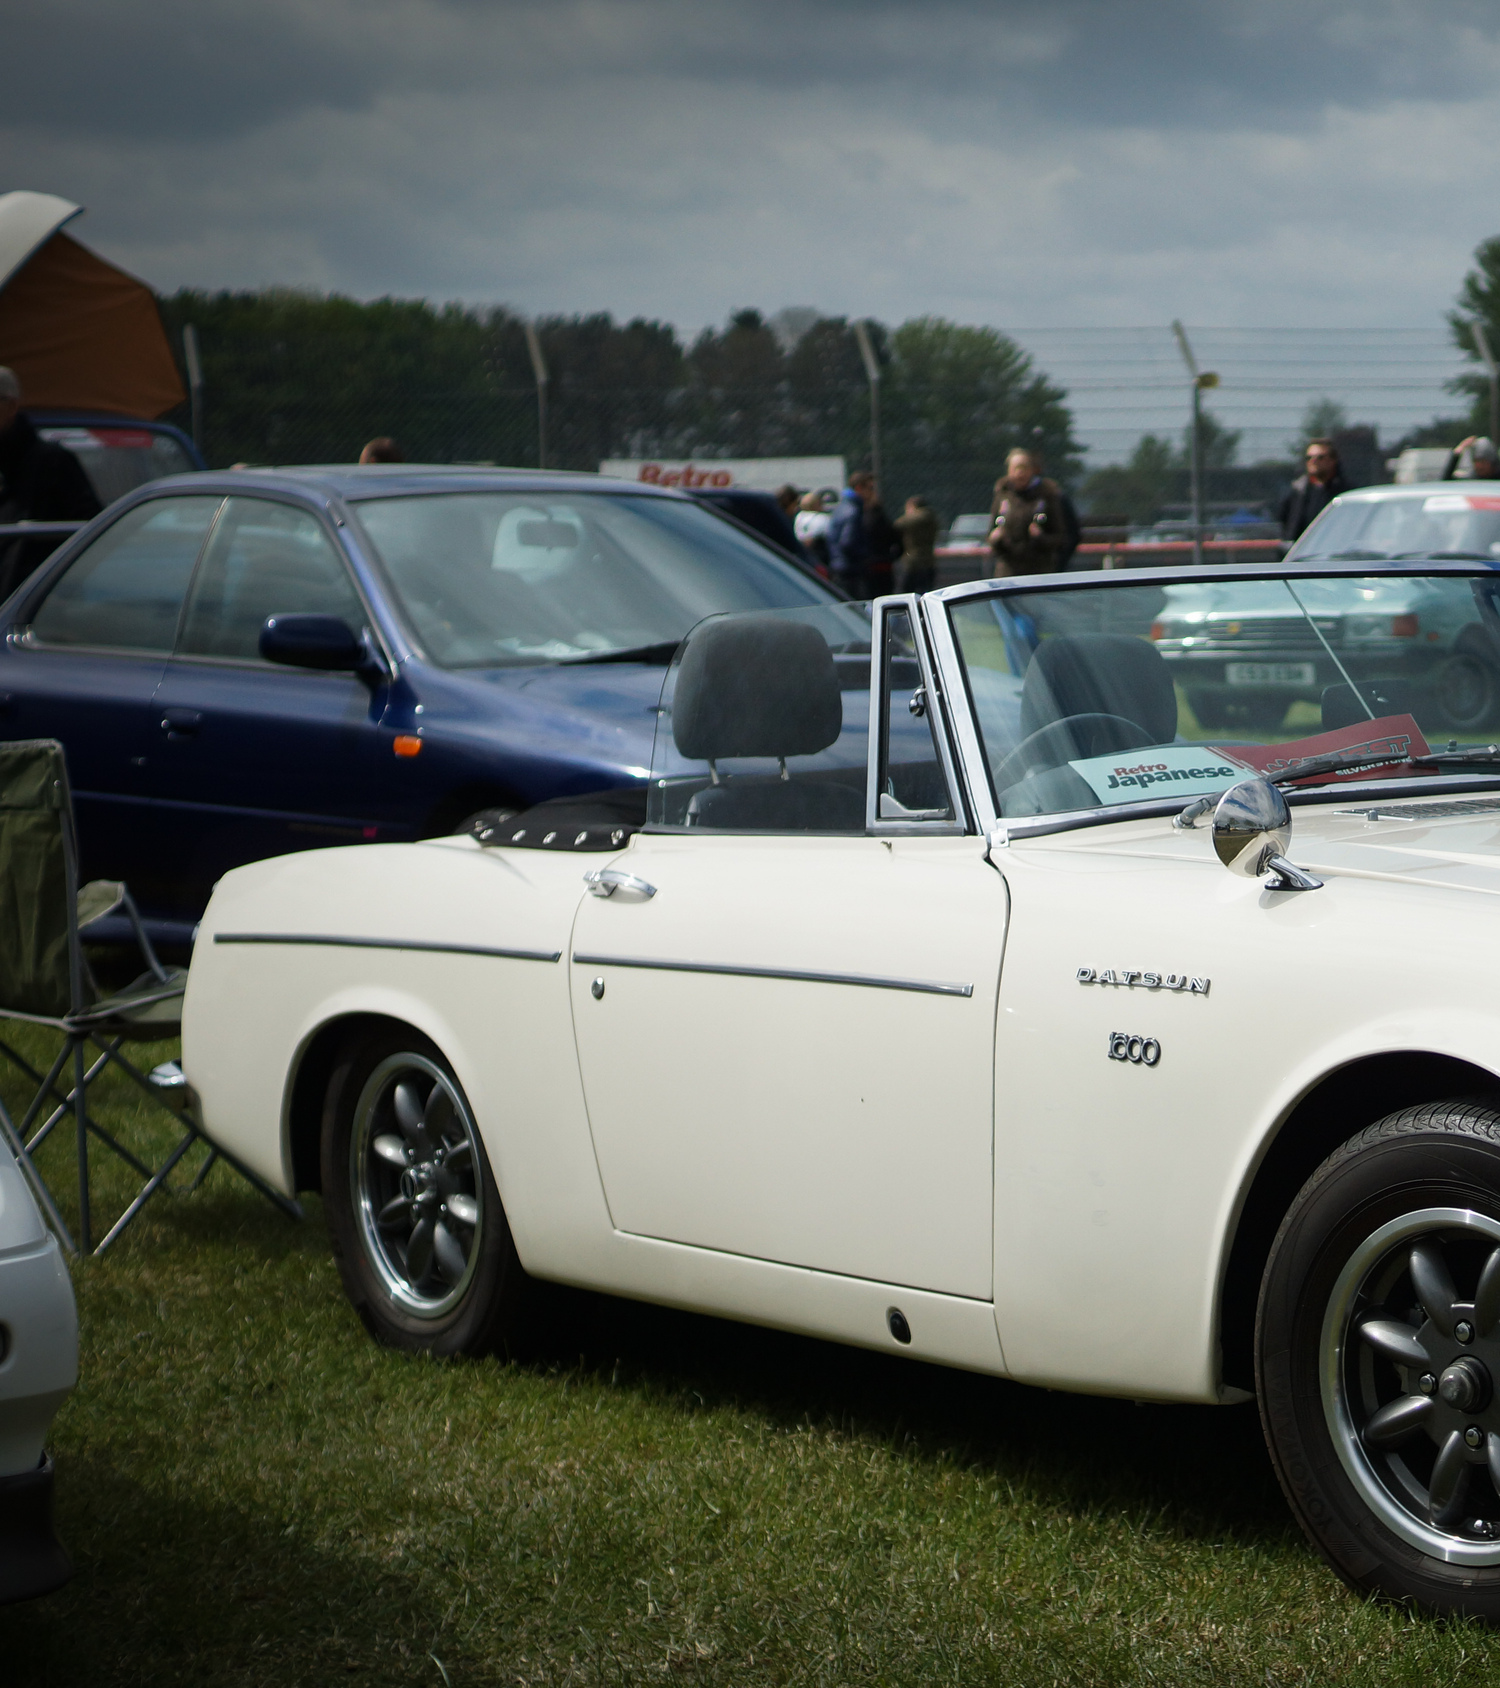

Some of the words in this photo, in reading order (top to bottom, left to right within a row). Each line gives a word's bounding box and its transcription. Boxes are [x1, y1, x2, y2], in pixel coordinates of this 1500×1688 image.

[638, 462, 733, 488] Retro
[1107, 766, 1235, 789] Japanese
[1113, 763, 1168, 776] Retro
[1076, 967, 1211, 994] DATSUN
[1108, 1031, 1161, 1066] 1600
[1267, 1373, 1334, 1535] YOKOHAMA
